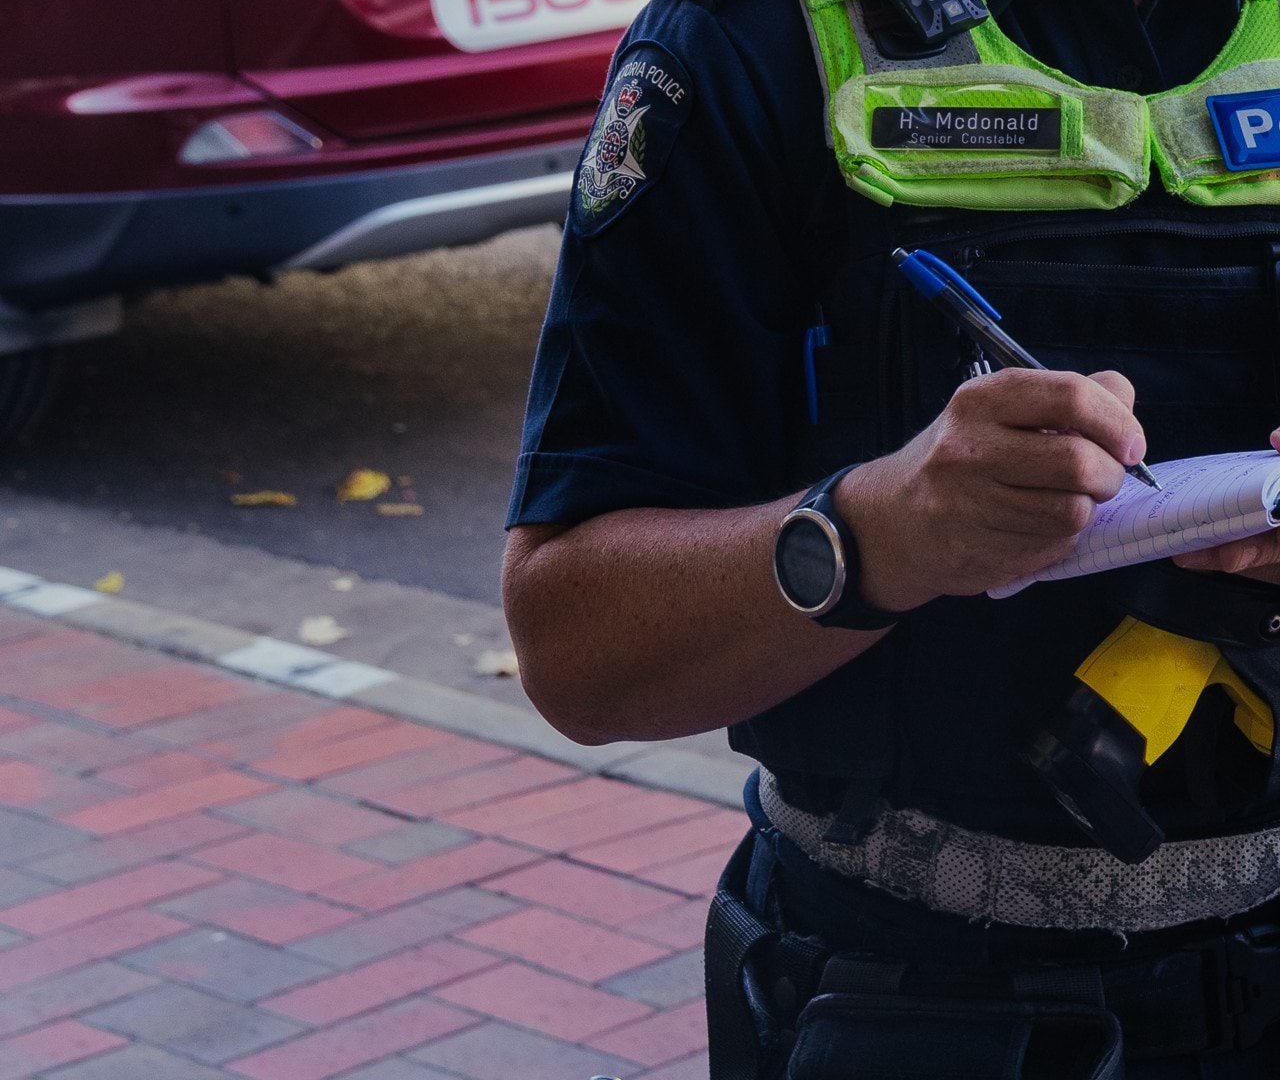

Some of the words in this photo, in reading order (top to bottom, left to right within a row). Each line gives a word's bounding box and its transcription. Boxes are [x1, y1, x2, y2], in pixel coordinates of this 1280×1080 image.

[645, 65, 686, 105] POLICE
[900, 111, 919, 129] H.
[936, 112, 1038, 131] Mcdonald
[911, 132, 952, 144] Senior
[961, 132, 1026, 145] Constable
[606, 177, 633, 195] RIGHT
